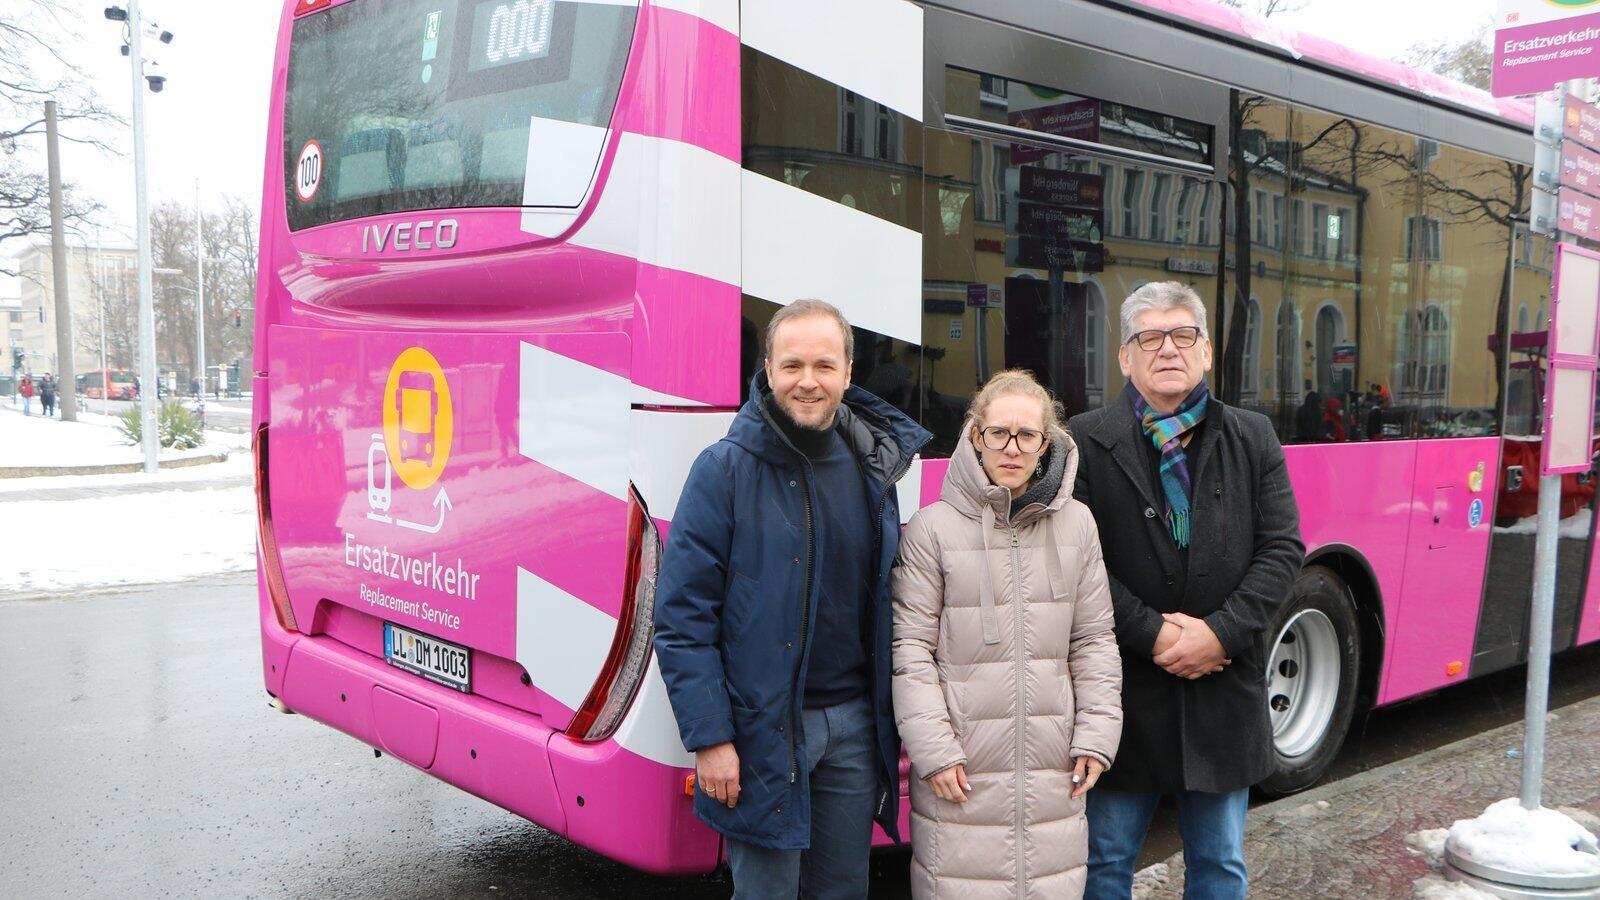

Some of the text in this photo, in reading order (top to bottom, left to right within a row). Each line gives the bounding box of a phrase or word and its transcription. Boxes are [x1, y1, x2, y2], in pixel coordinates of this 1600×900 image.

[1503, 27, 1600, 54] Ersatzverkehr
[1503, 46, 1593, 67] Replacement Service
[300, 153, 319, 189] 100
[362, 218, 459, 253] IVECO
[345, 532, 480, 601] Ersatzverkehr
[360, 583, 460, 630] Replacement Service
[393, 630, 407, 659] LL
[415, 639, 431, 668] DM
[434, 645, 467, 679] 1003
